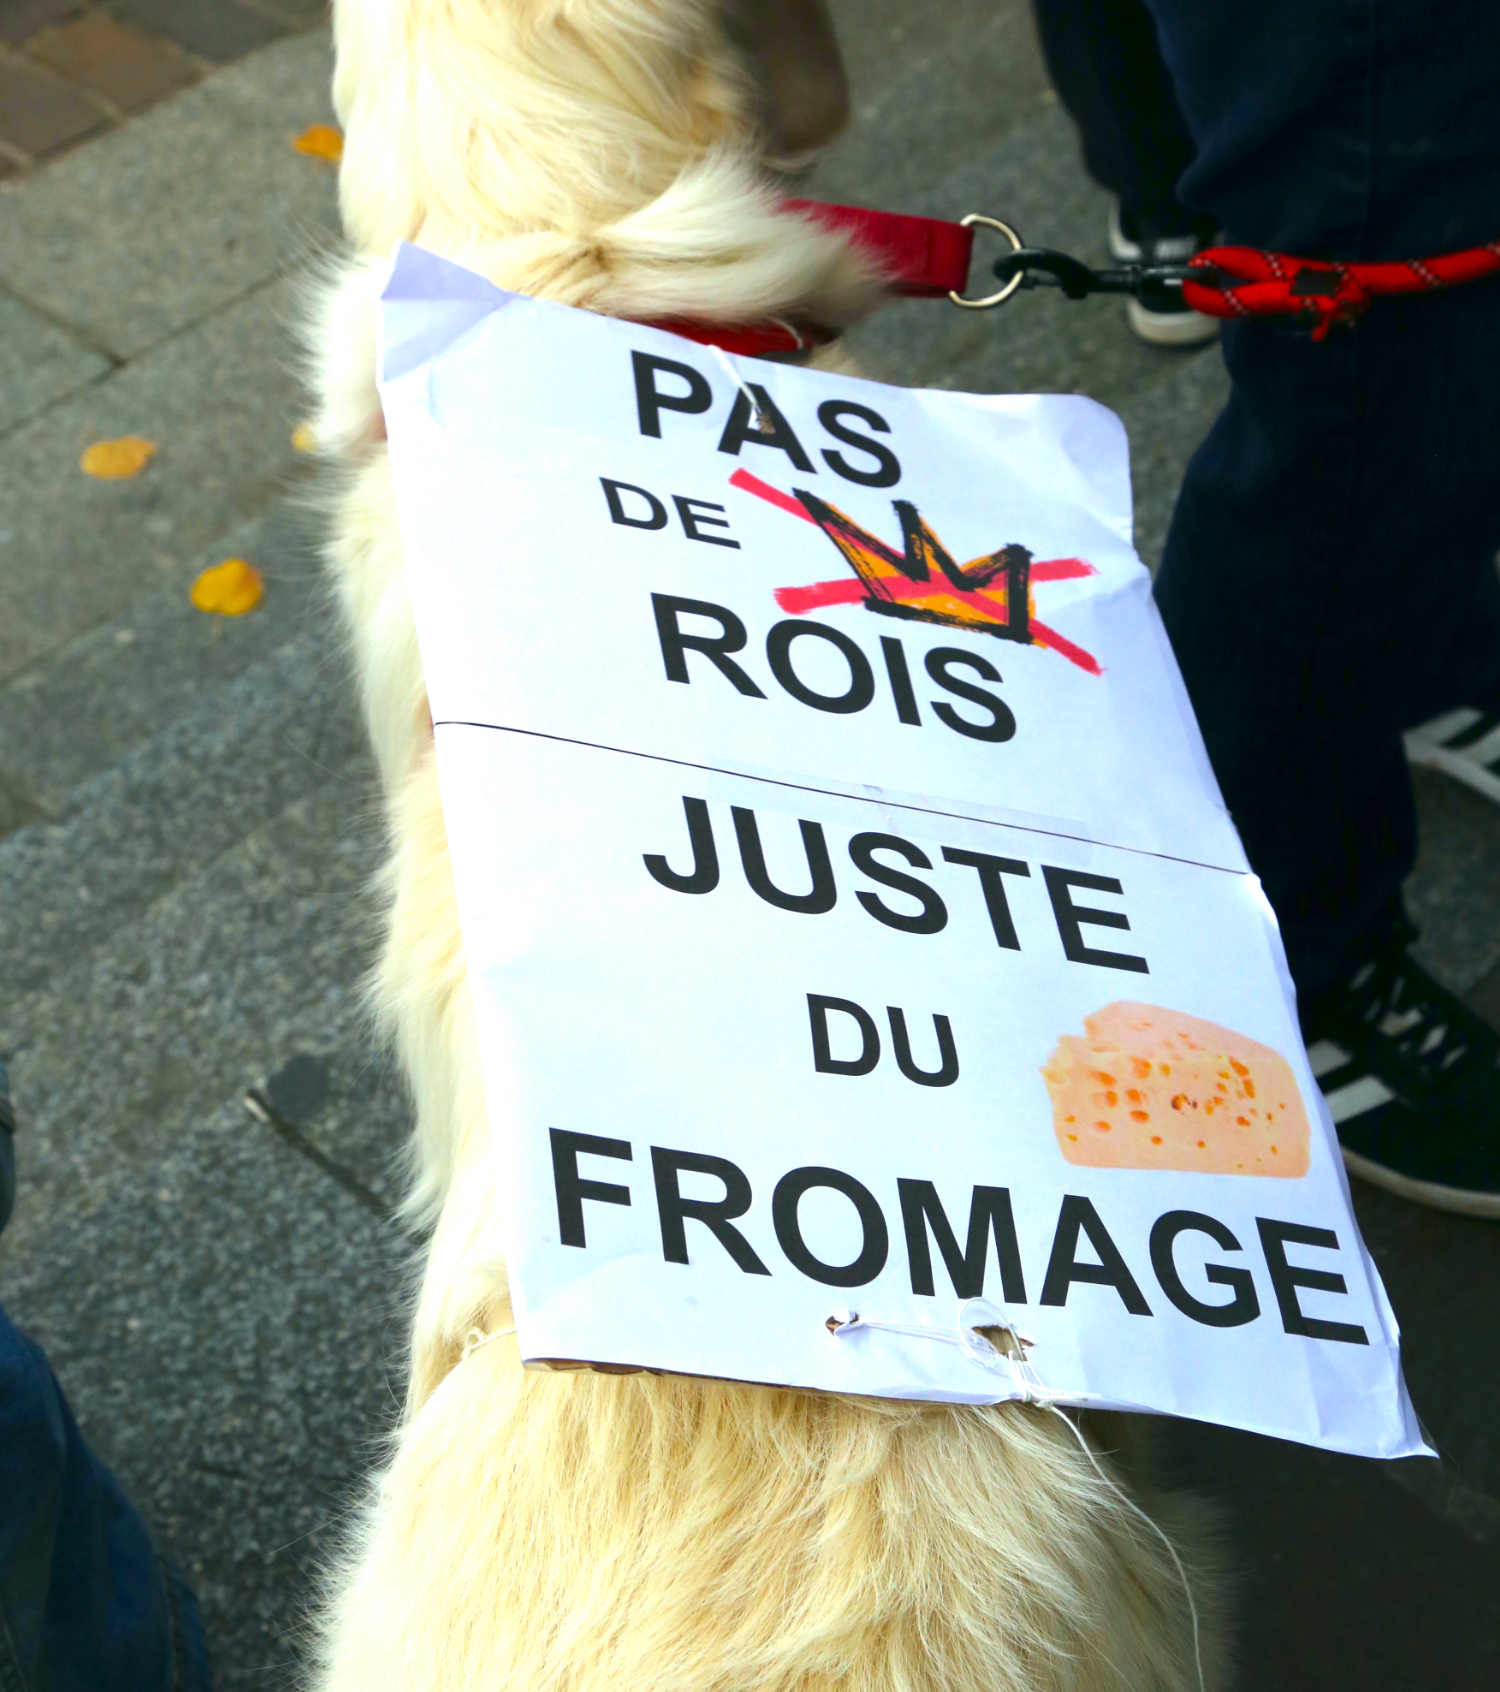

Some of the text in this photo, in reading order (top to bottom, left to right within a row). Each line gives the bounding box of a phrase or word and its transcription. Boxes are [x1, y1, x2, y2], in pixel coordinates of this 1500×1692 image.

[632, 351, 901, 488] PAS
[600, 477, 741, 550] DE
[651, 593, 1016, 743] ROIS
[642, 796, 1150, 974] JUSTE
[807, 993, 960, 1088] DU
[549, 1128, 1370, 1346] FROMAGE
